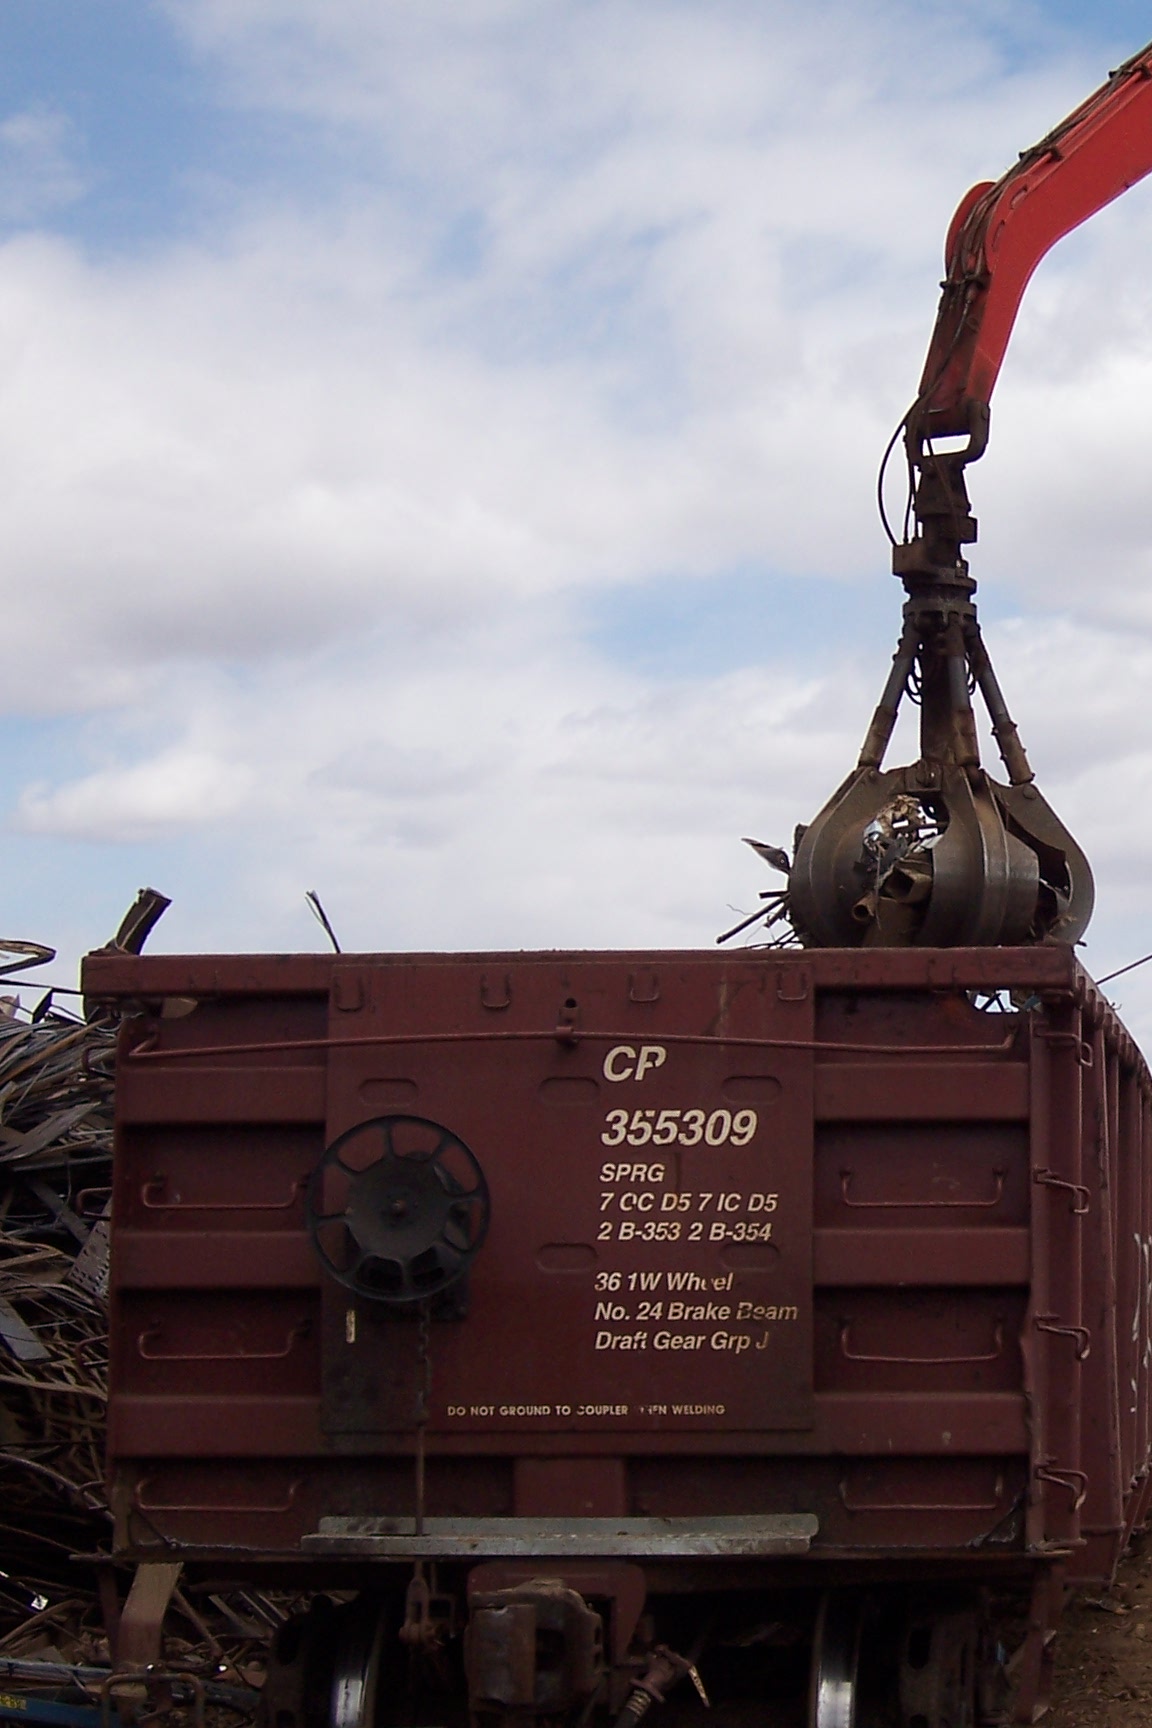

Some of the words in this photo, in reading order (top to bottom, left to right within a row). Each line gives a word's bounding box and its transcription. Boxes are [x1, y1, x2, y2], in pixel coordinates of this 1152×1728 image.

[603, 1046, 667, 1081] CP
[601, 1109, 758, 1146] 355309
[600, 1163, 665, 1182] SPRG
[600, 1192, 615, 1211] 7
[660, 1192, 692, 1211] D5
[698, 1192, 713, 1211] 7
[747, 1193, 779, 1212] D5
[597, 1221, 613, 1240] 2
[618, 1221, 682, 1241] B-353
[687, 1221, 704, 1241] 2
[708, 1222, 772, 1242] B-354
[594, 1272, 622, 1291] 36
[594, 1302, 630, 1320] No.
[636, 1302, 663, 1320] 24
[667, 1302, 731, 1320] Brake
[736, 1302, 798, 1320] Beam
[595, 1332, 647, 1349] Draft
[653, 1332, 706, 1350] Gear
[710, 1332, 751, 1354] Grp
[755, 1331, 769, 1349] J
[447, 1406, 466, 1416] DO
[470, 1406, 495, 1416] NOT
[499, 1405, 551, 1416] GROUND
[555, 1405, 571, 1415] TO
[577, 1405, 628, 1415] COUPLER
[672, 1405, 726, 1415] WELDING
